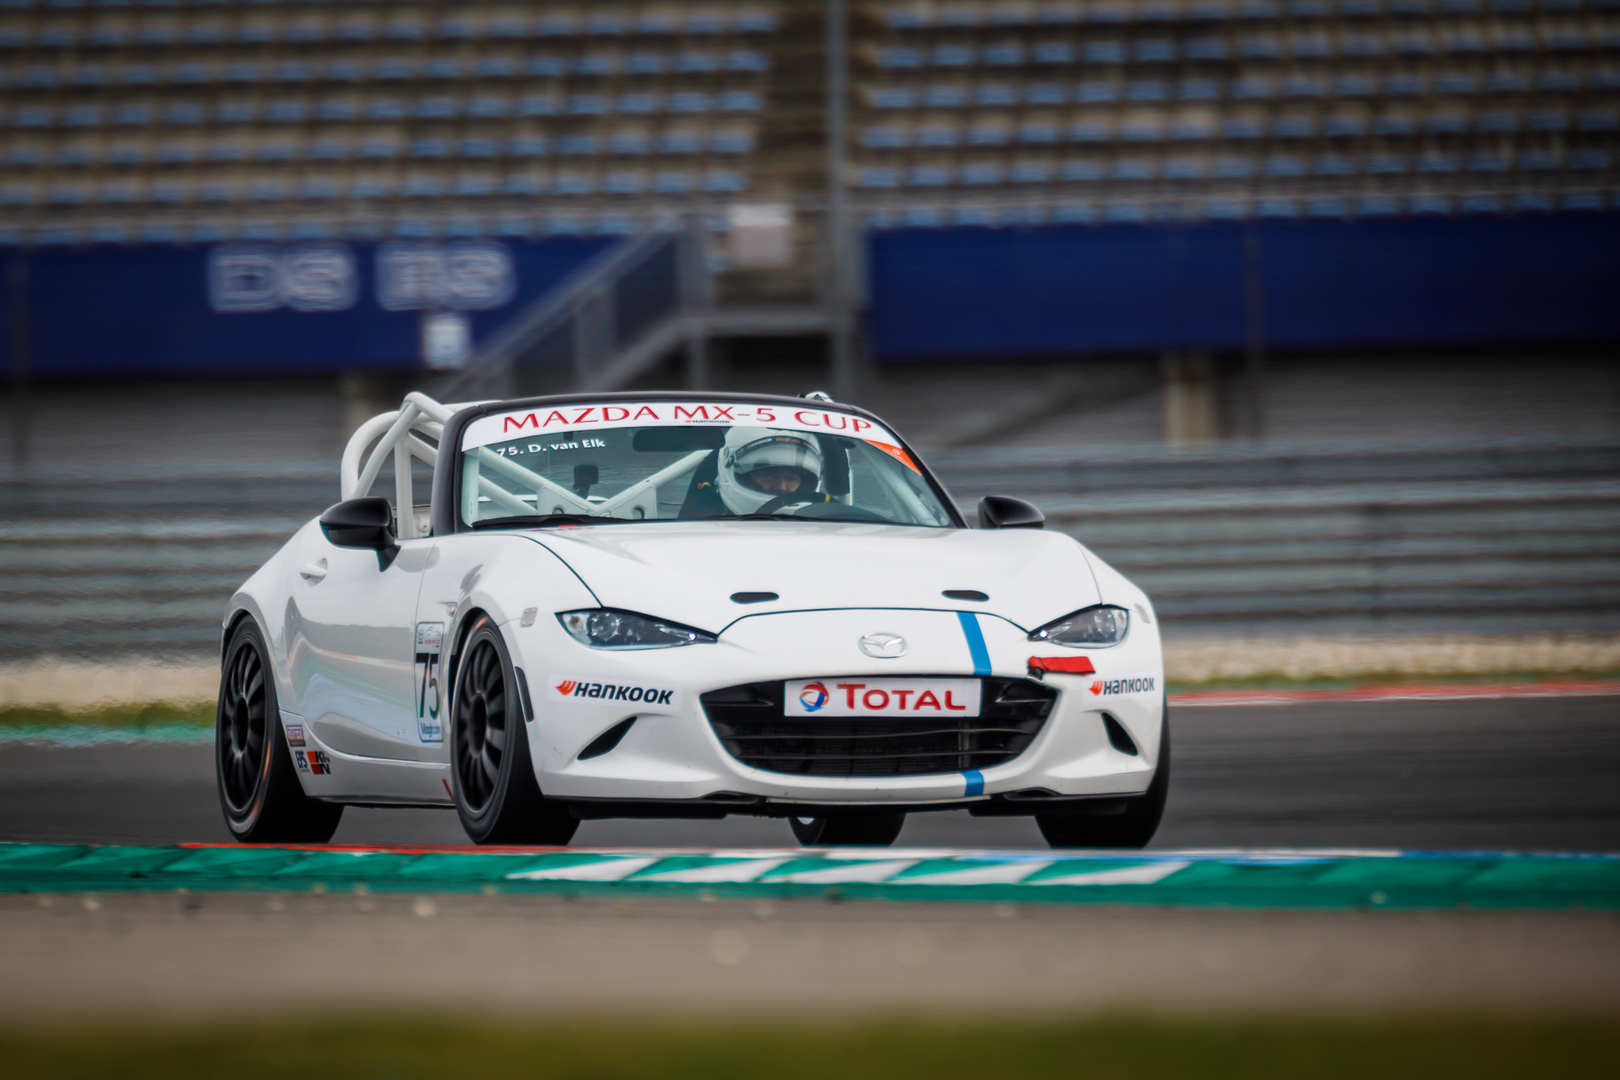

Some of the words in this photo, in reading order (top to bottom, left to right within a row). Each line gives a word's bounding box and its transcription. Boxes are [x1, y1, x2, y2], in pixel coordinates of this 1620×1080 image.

[503, 405, 660, 434] MAZDA
[673, 404, 776, 422] MX-5
[793, 410, 872, 433] CUP
[496, 446, 524, 458] 75.
[528, 443, 547, 454] D.
[550, 440, 579, 451] van
[582, 438, 606, 449] Elk
[415, 652, 440, 720] 75
[836, 683, 967, 711] TOTAL
